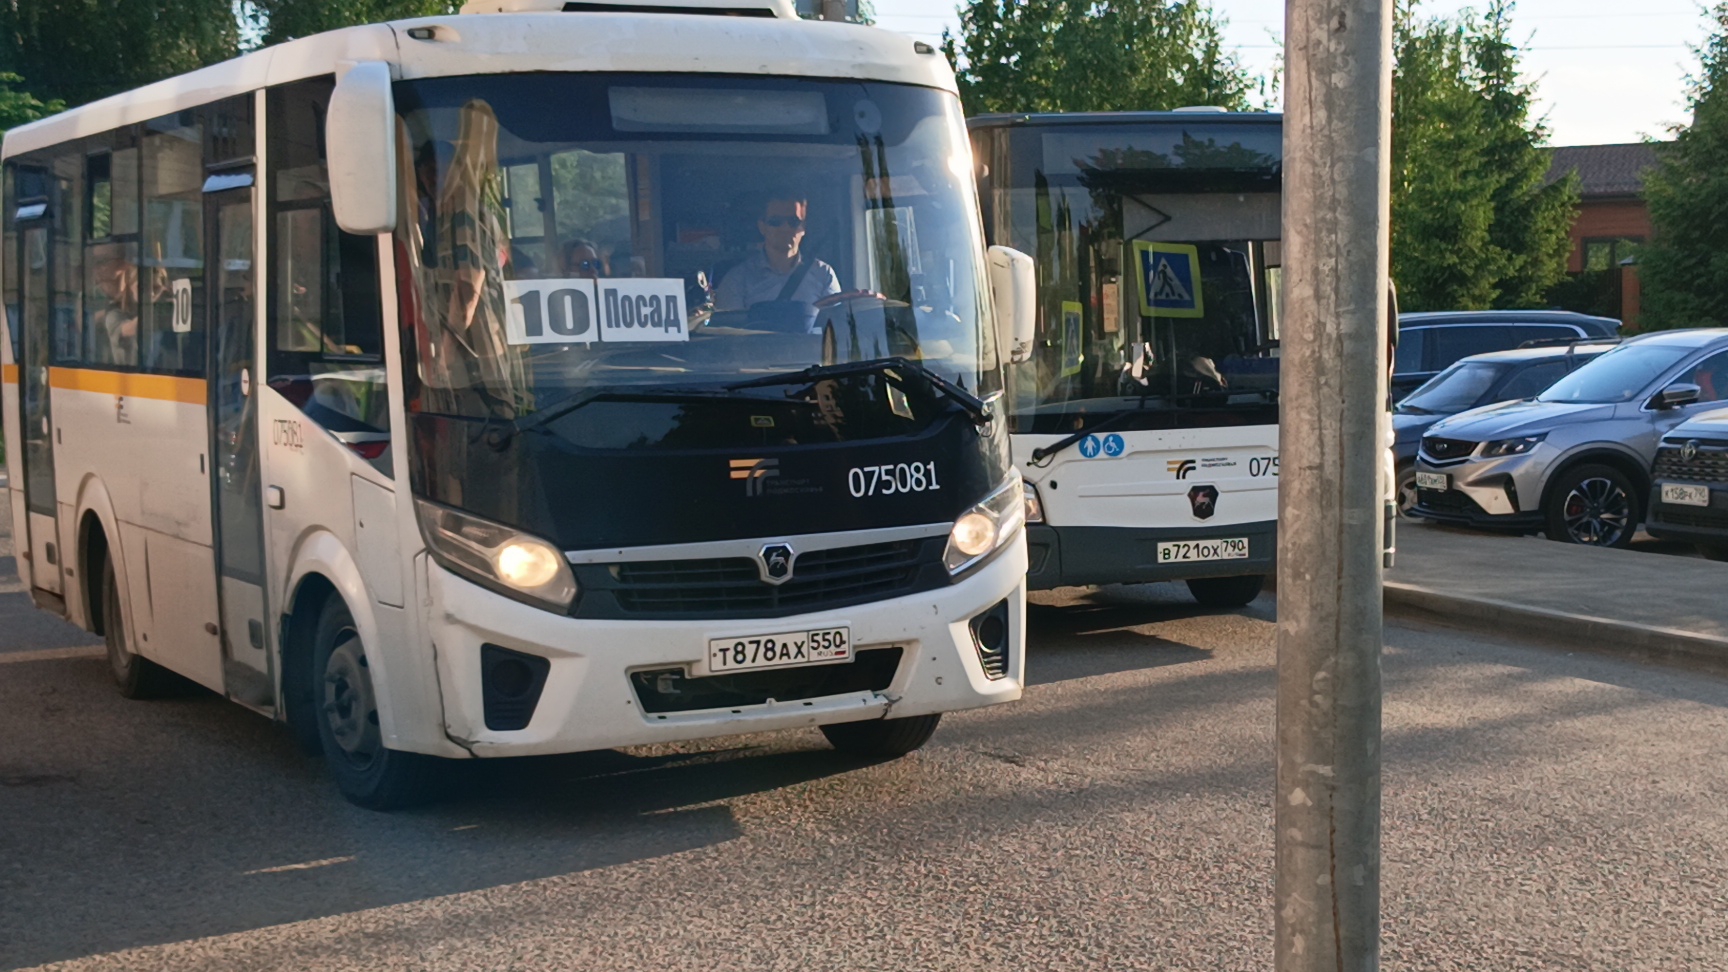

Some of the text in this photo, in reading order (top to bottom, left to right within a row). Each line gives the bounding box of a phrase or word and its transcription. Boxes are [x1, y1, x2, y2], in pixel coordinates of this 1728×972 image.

[173, 287, 190, 325] 10
[510, 288, 682, 337] 10 Посад
[848, 461, 941, 498] 075081
[1162, 539, 1245, 561] В721ОХ 790
[718, 630, 844, 667] Т878АХ 550
